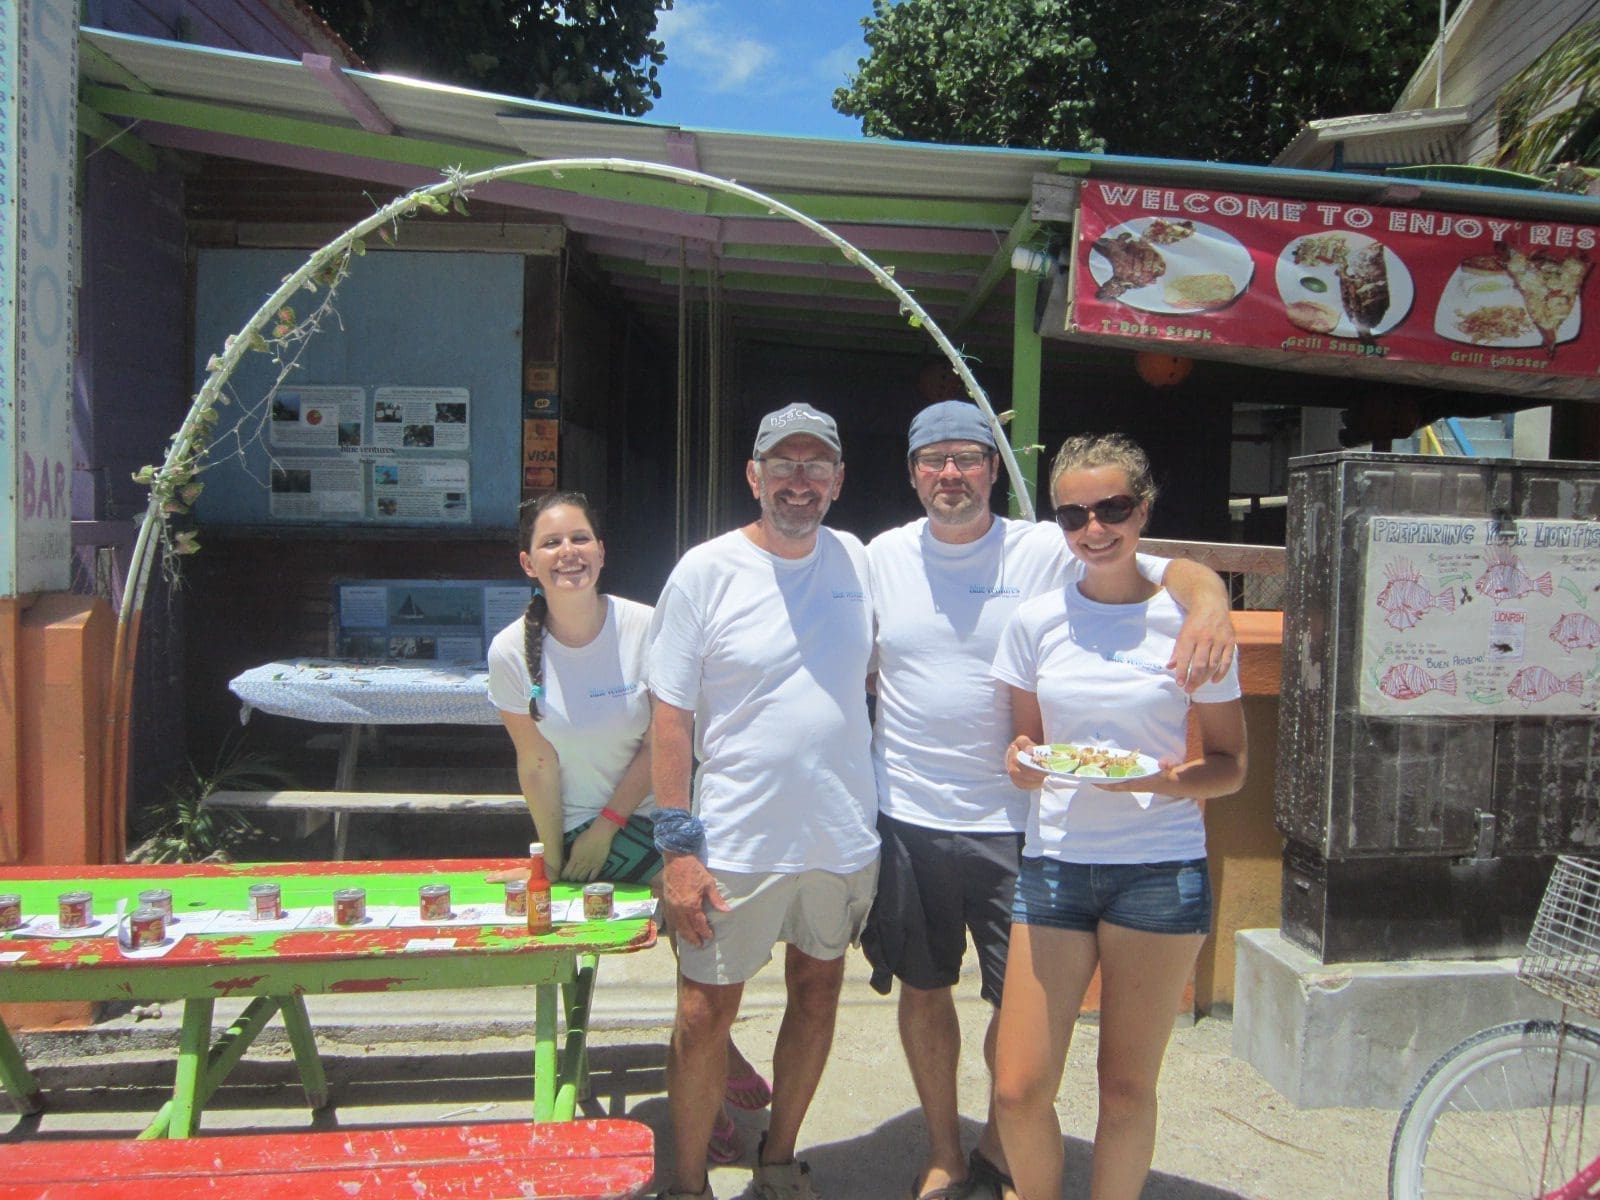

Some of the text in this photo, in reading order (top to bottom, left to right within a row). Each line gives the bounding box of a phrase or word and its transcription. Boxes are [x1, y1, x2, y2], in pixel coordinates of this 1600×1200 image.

[1100, 184, 1301, 222] WELCOME
[1317, 205, 1373, 228] TO
[1102, 319, 1212, 340] T-Bone Steak
[1287, 336, 1390, 355] Grill Snapper
[1451, 351, 1483, 364] Grill
[527, 450, 556, 461] VISA
[23, 451, 67, 520] BAR
[1373, 518, 1476, 545] PREPARING
[1425, 657, 1449, 669] BUEN
